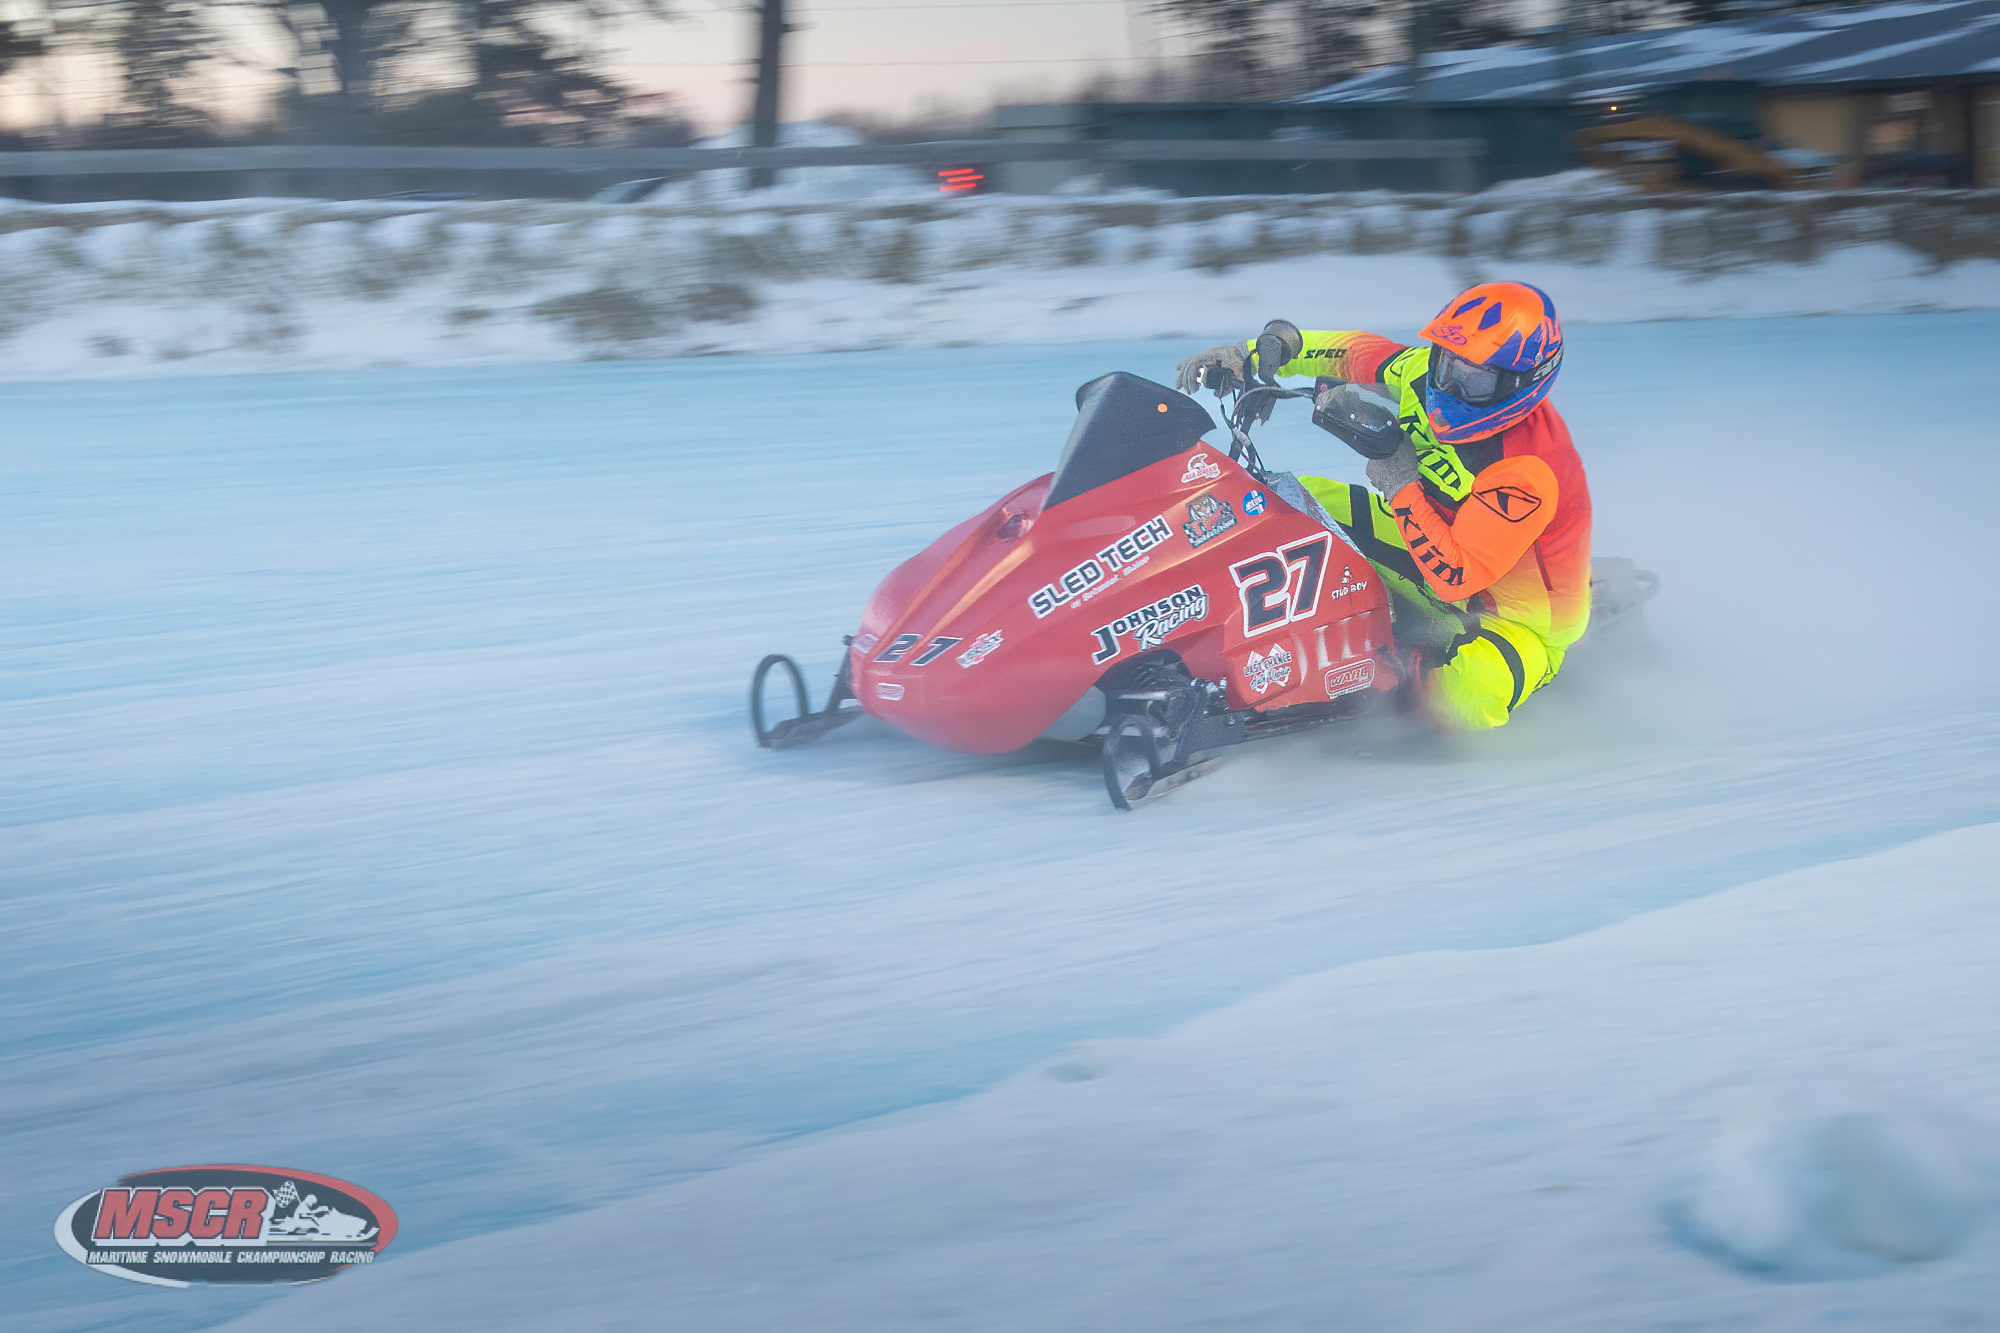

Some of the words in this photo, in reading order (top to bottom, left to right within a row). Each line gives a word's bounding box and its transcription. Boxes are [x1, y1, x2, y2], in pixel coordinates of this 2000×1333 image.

[1028, 559, 1105, 619] SLED
[1096, 514, 1174, 572] TECH
[1229, 531, 1332, 638] 27
[1331, 585, 1349, 600] STUD
[1350, 581, 1367, 593] BOY
[1091, 584, 1203, 665] JOHNSON
[1133, 594, 1209, 651] Racing
[871, 633, 964, 666] 27
[1243, 661, 1264, 677] LAST
[1264, 652, 1292, 671] CHANCE
[1329, 666, 1369, 688] WAHL
